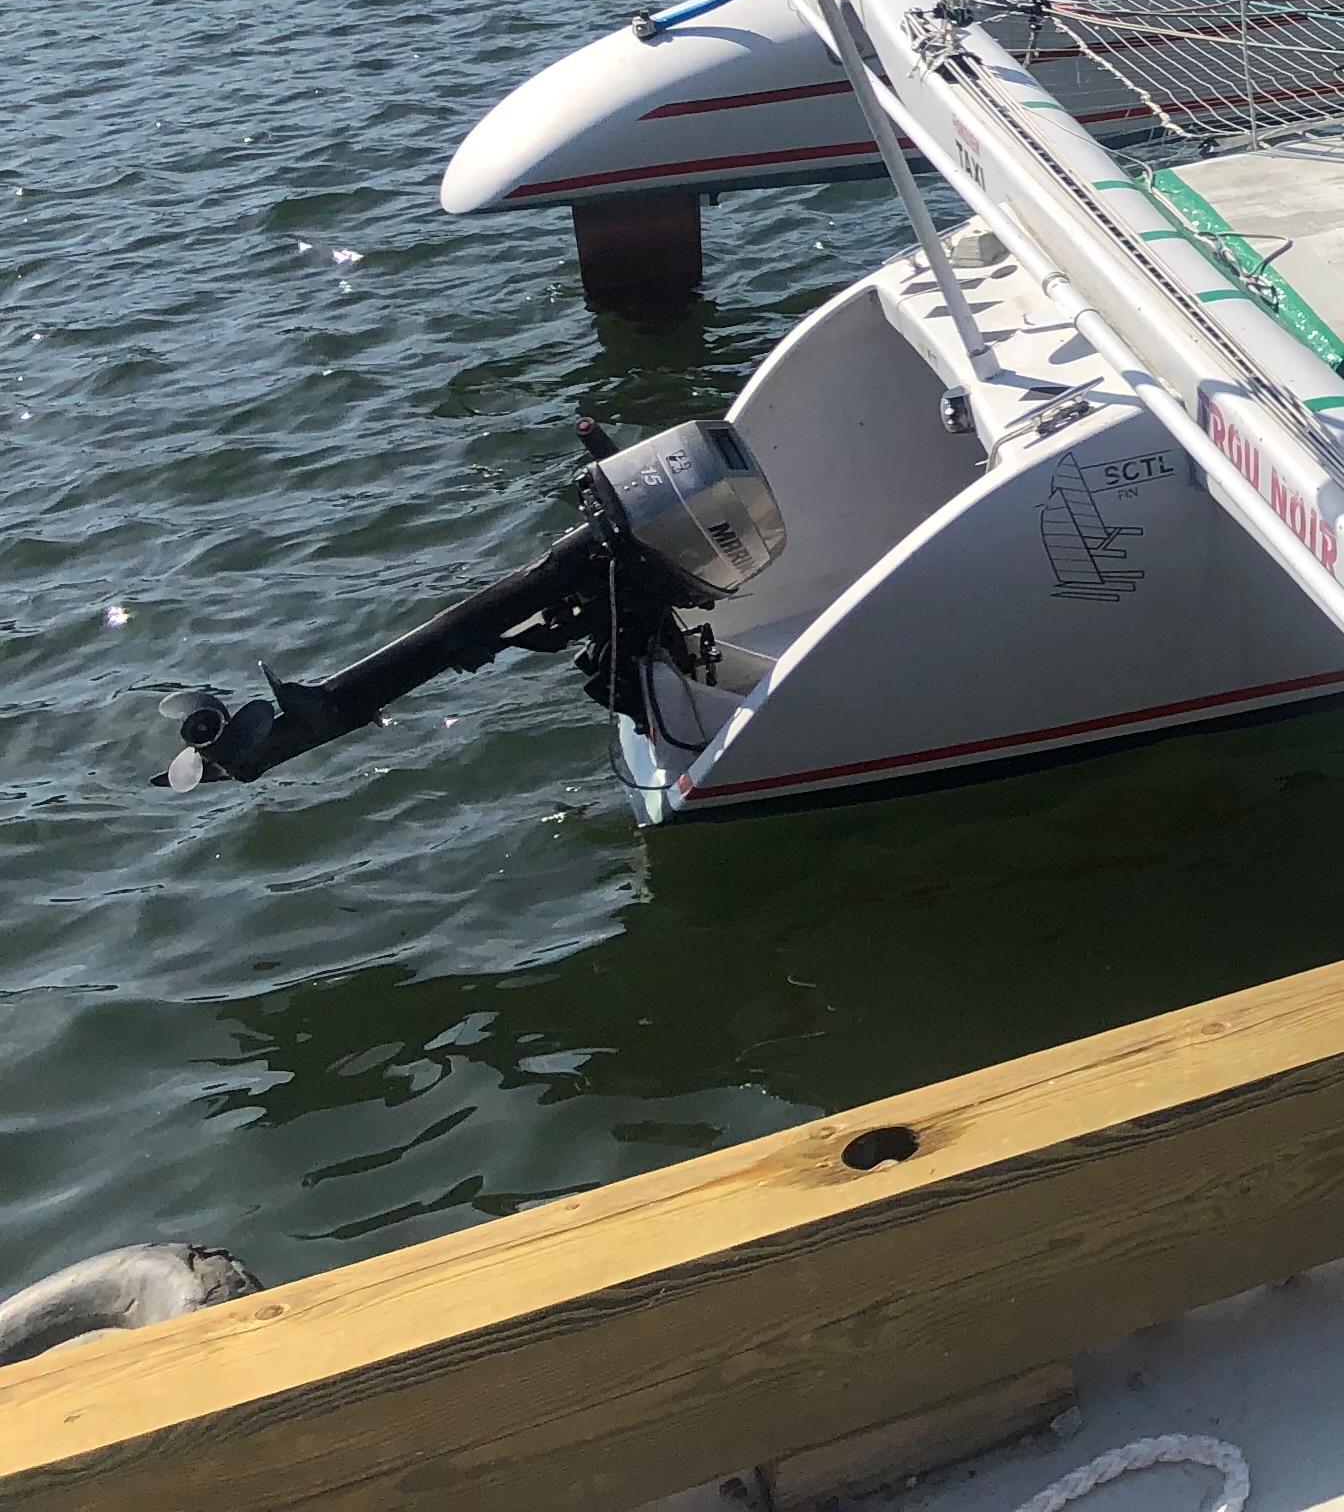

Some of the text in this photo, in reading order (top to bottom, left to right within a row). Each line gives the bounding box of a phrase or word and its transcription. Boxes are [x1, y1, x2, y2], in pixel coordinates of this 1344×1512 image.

[954, 137, 987, 193] TAXI
[640, 466, 664, 487] 15
[1104, 455, 1174, 485] SCTL
[1271, 465, 1338, 578] NOIR
